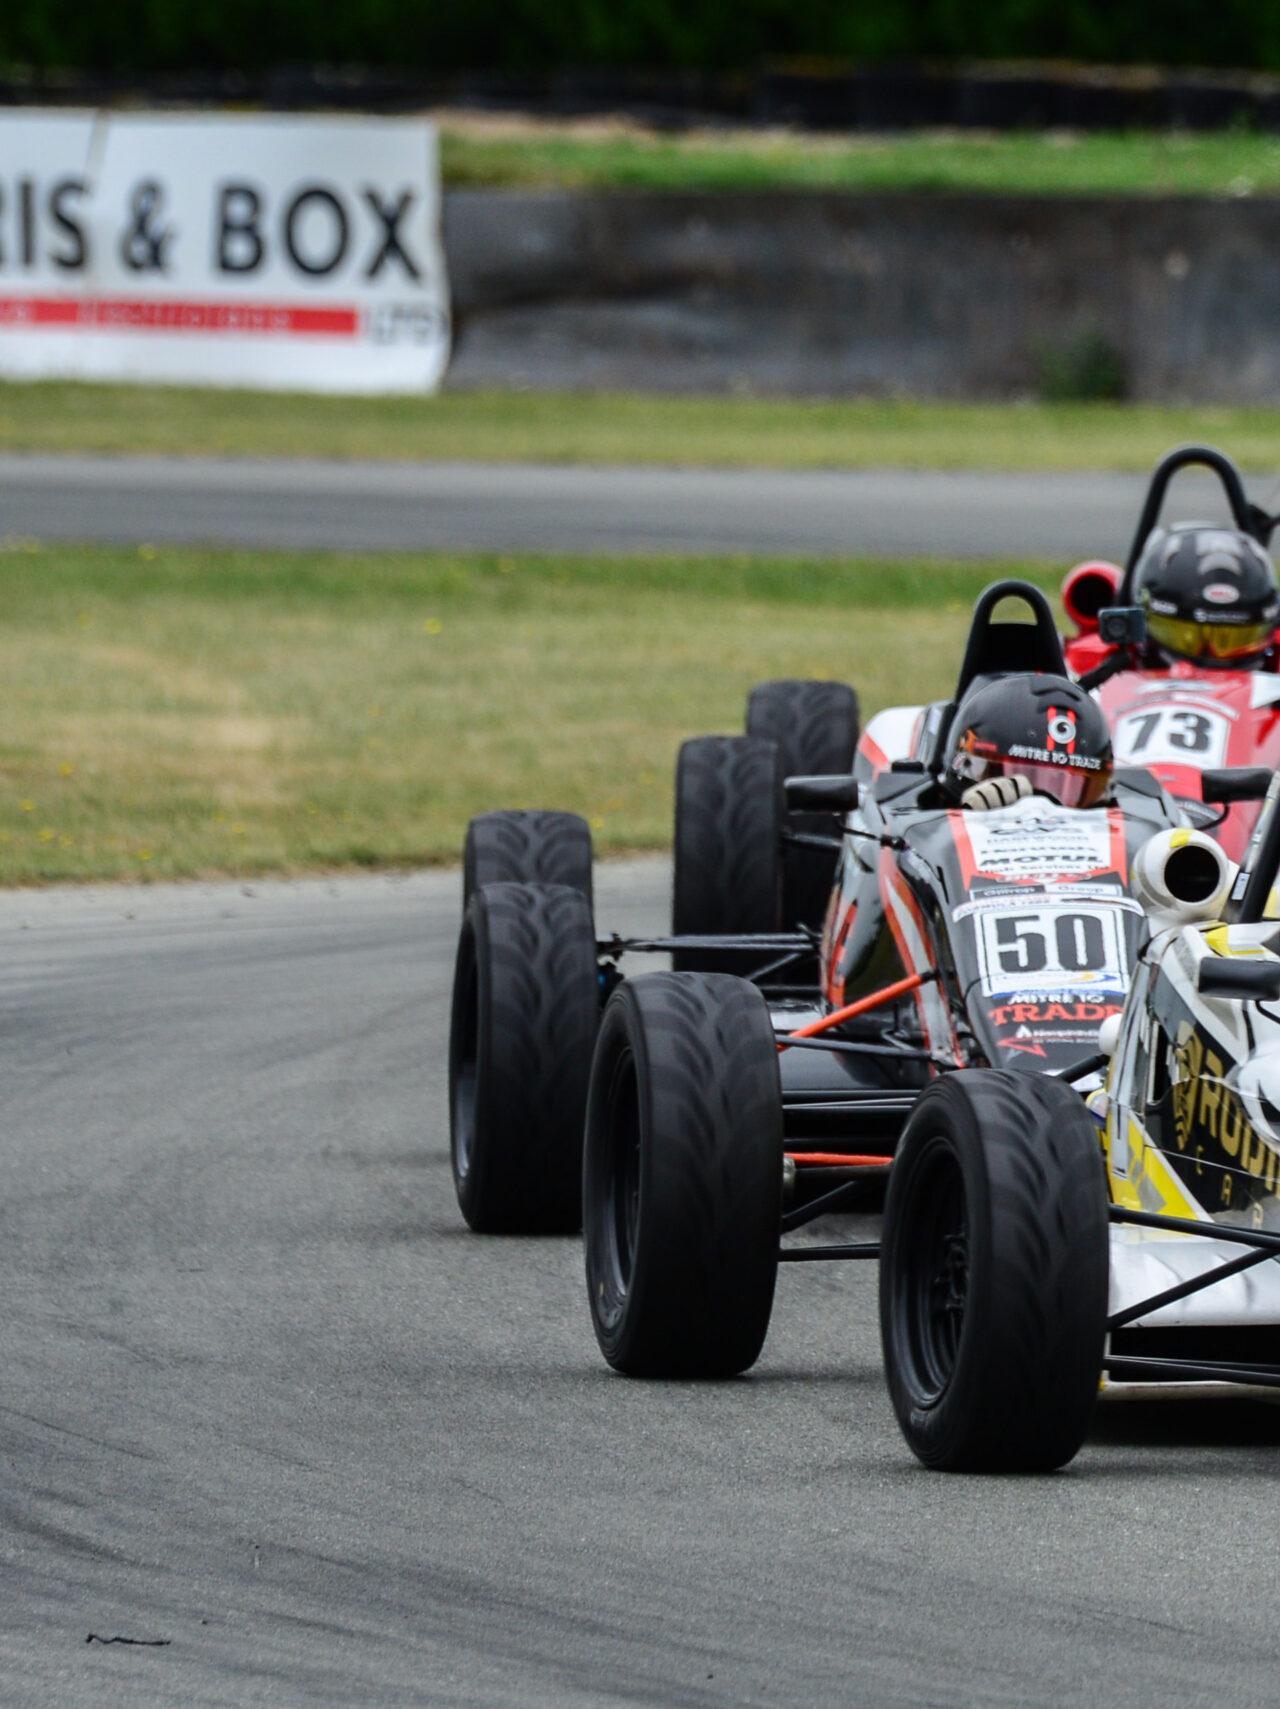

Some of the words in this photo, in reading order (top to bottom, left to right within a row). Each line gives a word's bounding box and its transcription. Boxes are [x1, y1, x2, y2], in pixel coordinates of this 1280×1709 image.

[121, 179, 172, 272] &
[217, 184, 421, 280] BOX
[1008, 744, 1050, 762] MITRE
[1127, 711, 1212, 754] 73
[980, 854, 1104, 866] MOTUL
[996, 914, 1107, 973] 50
